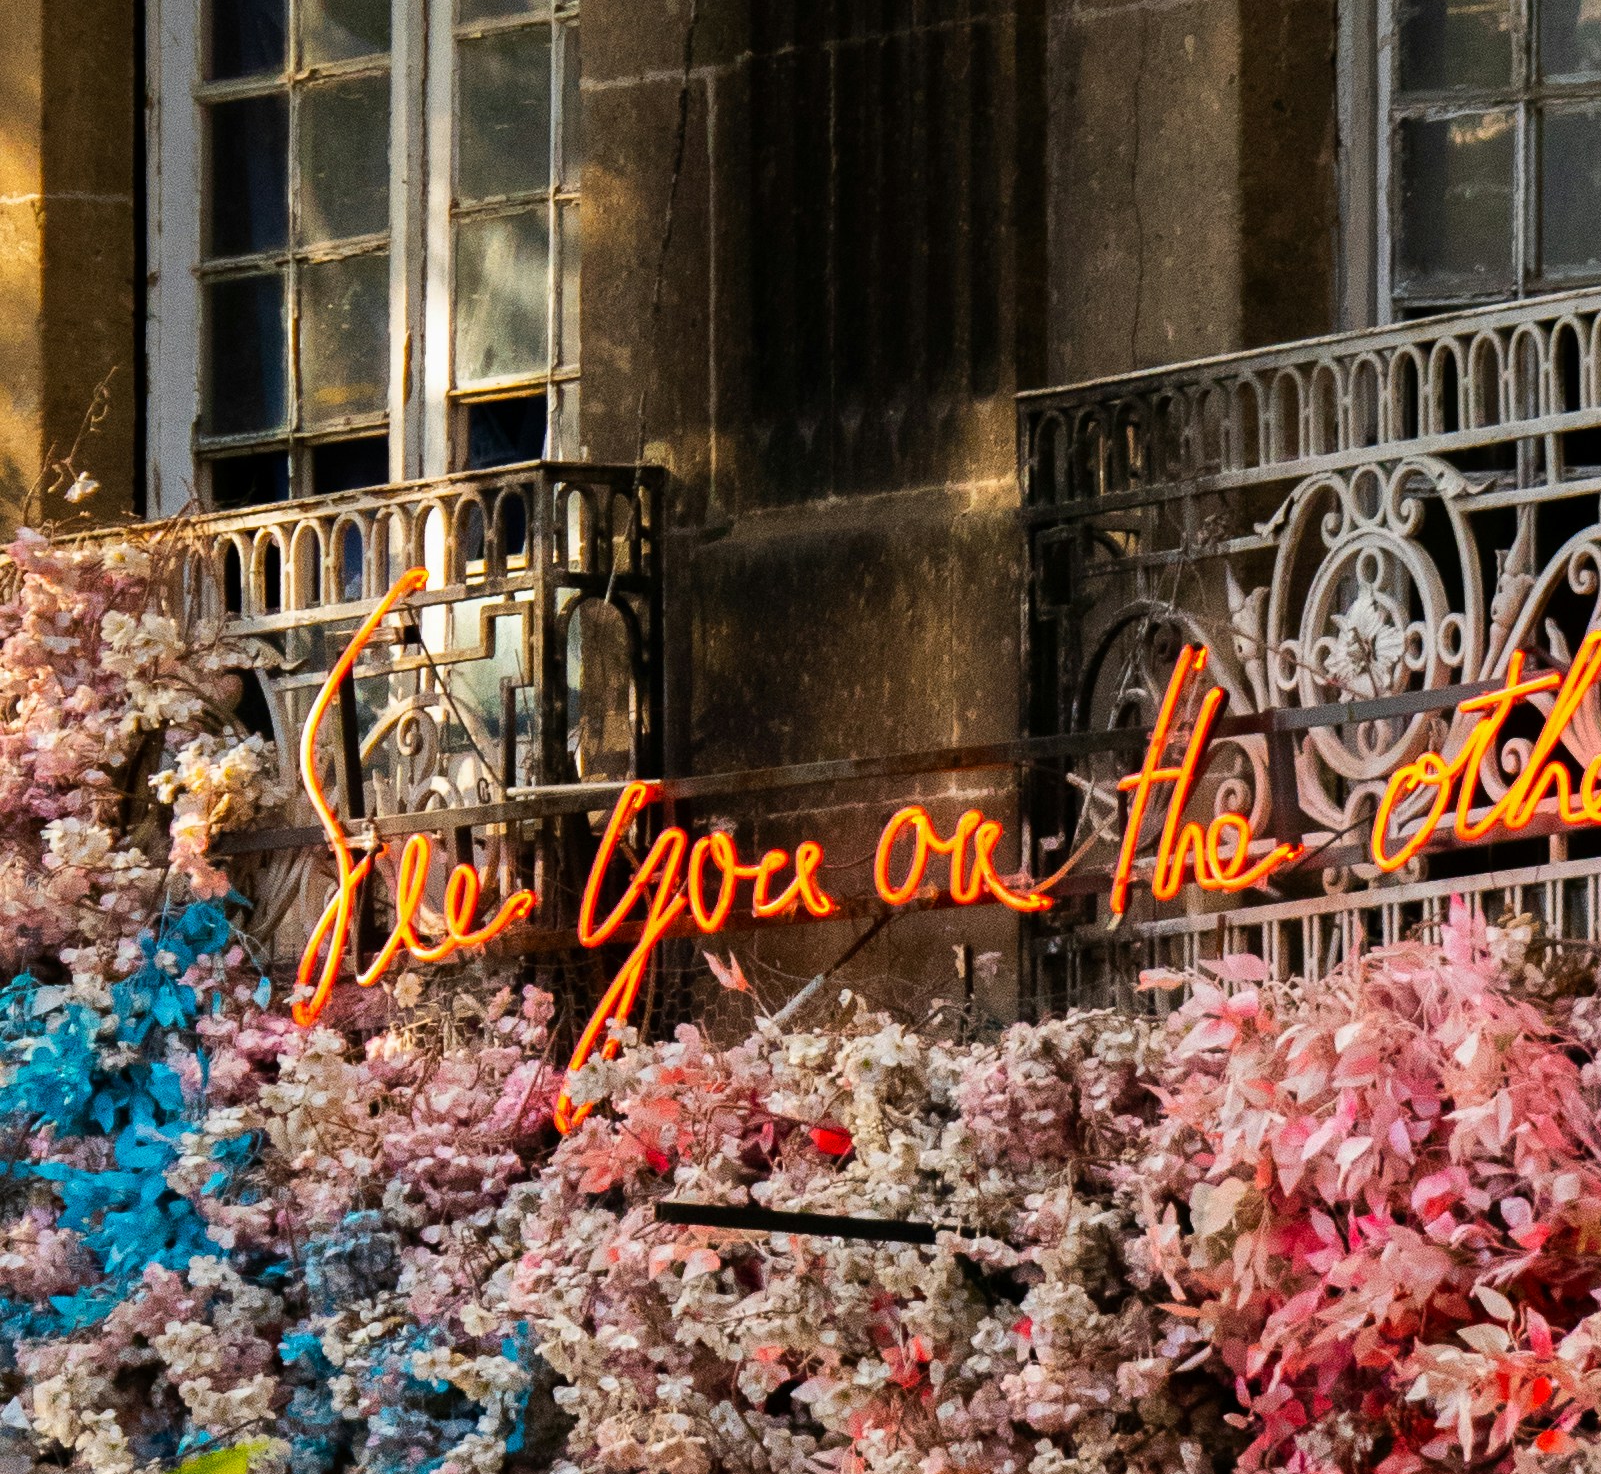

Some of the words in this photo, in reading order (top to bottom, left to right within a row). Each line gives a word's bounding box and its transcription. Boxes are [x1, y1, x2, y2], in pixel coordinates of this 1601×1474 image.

[292, 568, 536, 1027] See
[874, 805, 1053, 913] on
[1111, 642, 1306, 915] the
